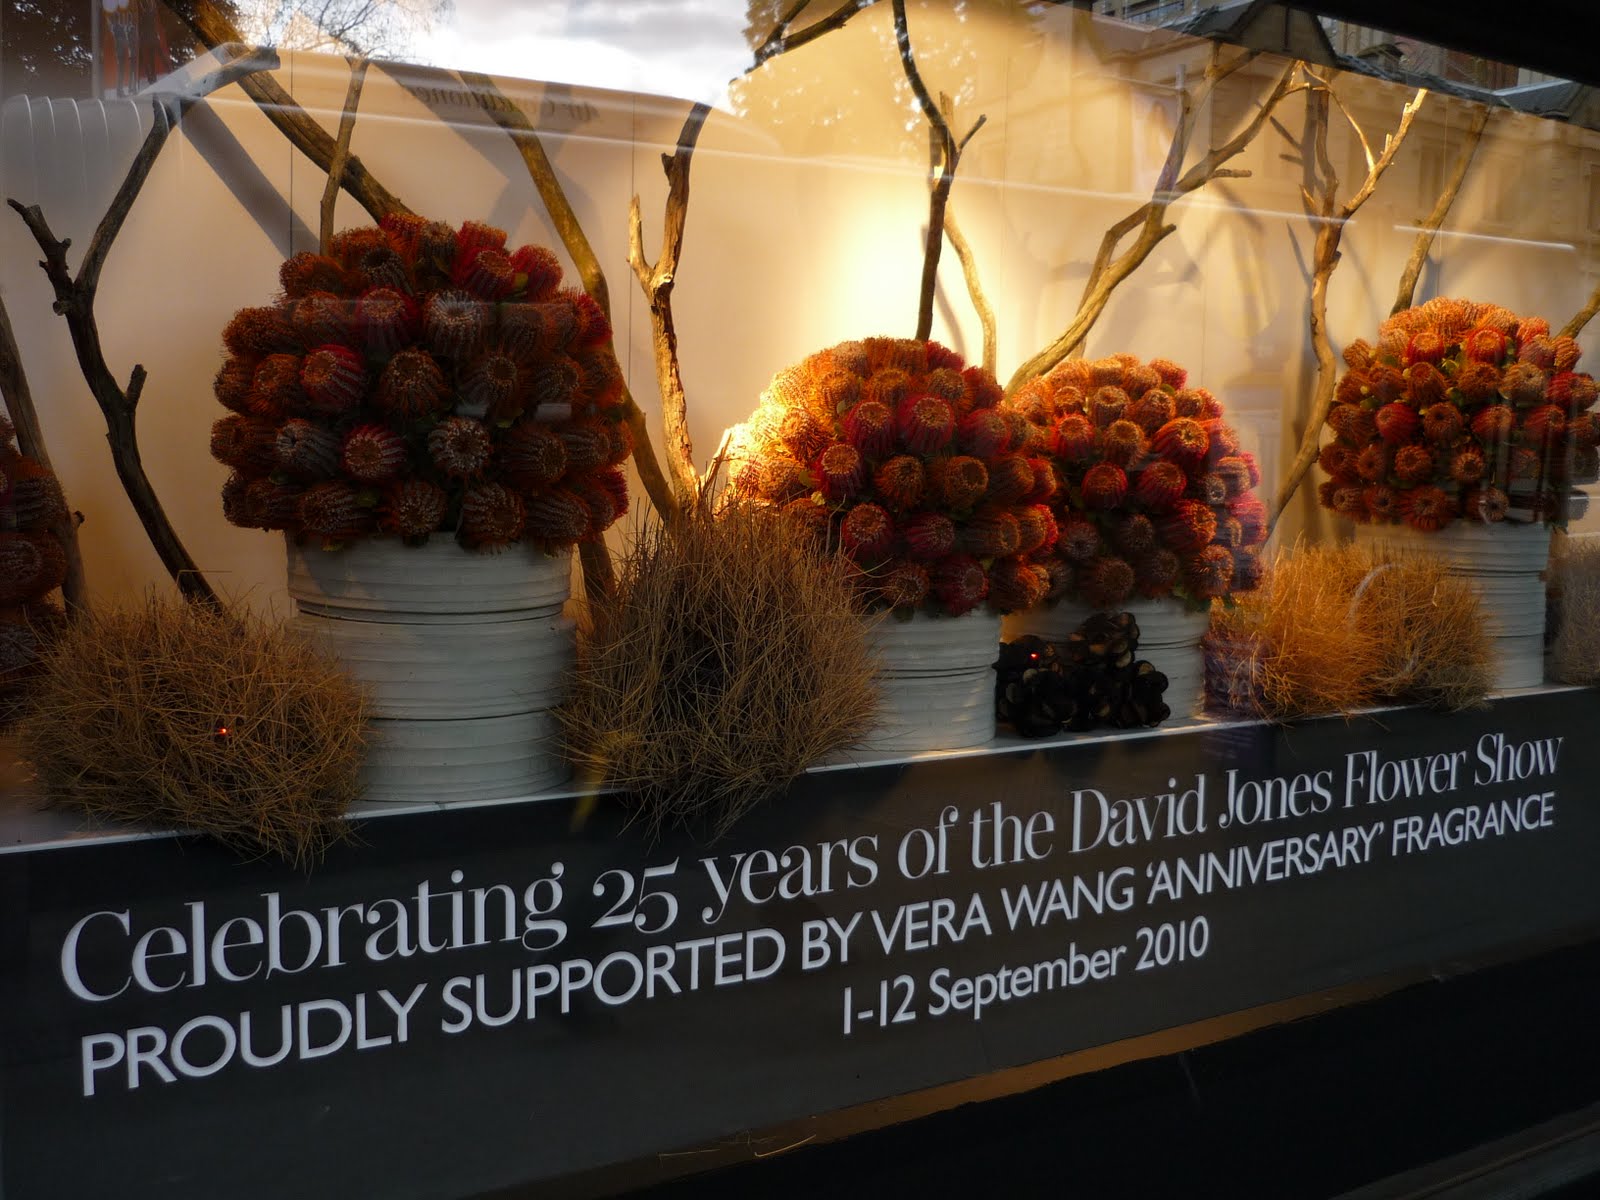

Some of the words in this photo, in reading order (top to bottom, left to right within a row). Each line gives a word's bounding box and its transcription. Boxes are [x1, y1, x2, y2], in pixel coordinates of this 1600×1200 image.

[60, 861, 568, 1003] Celebrating
[591, 856, 680, 935] 25
[698, 834, 879, 926] years
[897, 805, 960, 880] of
[969, 801, 1056, 869] the
[1068, 776, 1207, 854] David
[1218, 768, 1333, 829] Jones
[1343, 750, 1467, 809] Flower
[1473, 733, 1564, 787] Show
[81, 983, 428, 1098] PROUDLY
[441, 928, 787, 1034] SUPPORTED
[800, 911, 864, 971] BY
[869, 892, 993, 956] VERA
[1000, 865, 1136, 932] WANG
[1390, 791, 1556, 858] FRAGRANCE
[842, 974, 918, 1036] 1-12
[928, 942, 1128, 1021] September
[1134, 915, 1210, 972] 2010
